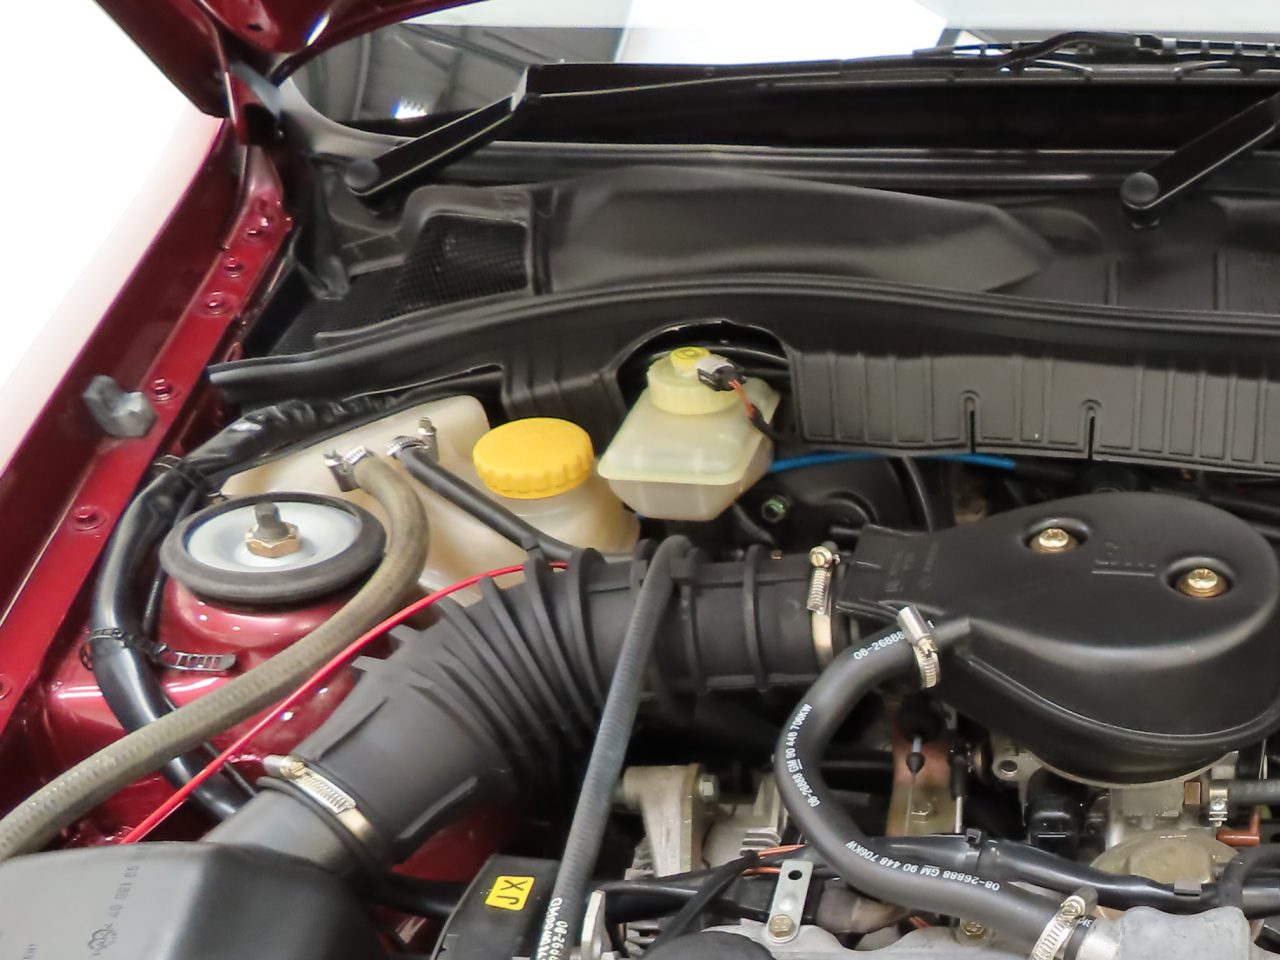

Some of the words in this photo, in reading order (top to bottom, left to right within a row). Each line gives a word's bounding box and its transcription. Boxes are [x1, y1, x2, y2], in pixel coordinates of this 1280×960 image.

[845, 840, 879, 863] 706KW
[902, 862, 919, 875] 90
[920, 864, 940, 878] GM
[495, 879, 529, 906] JX
